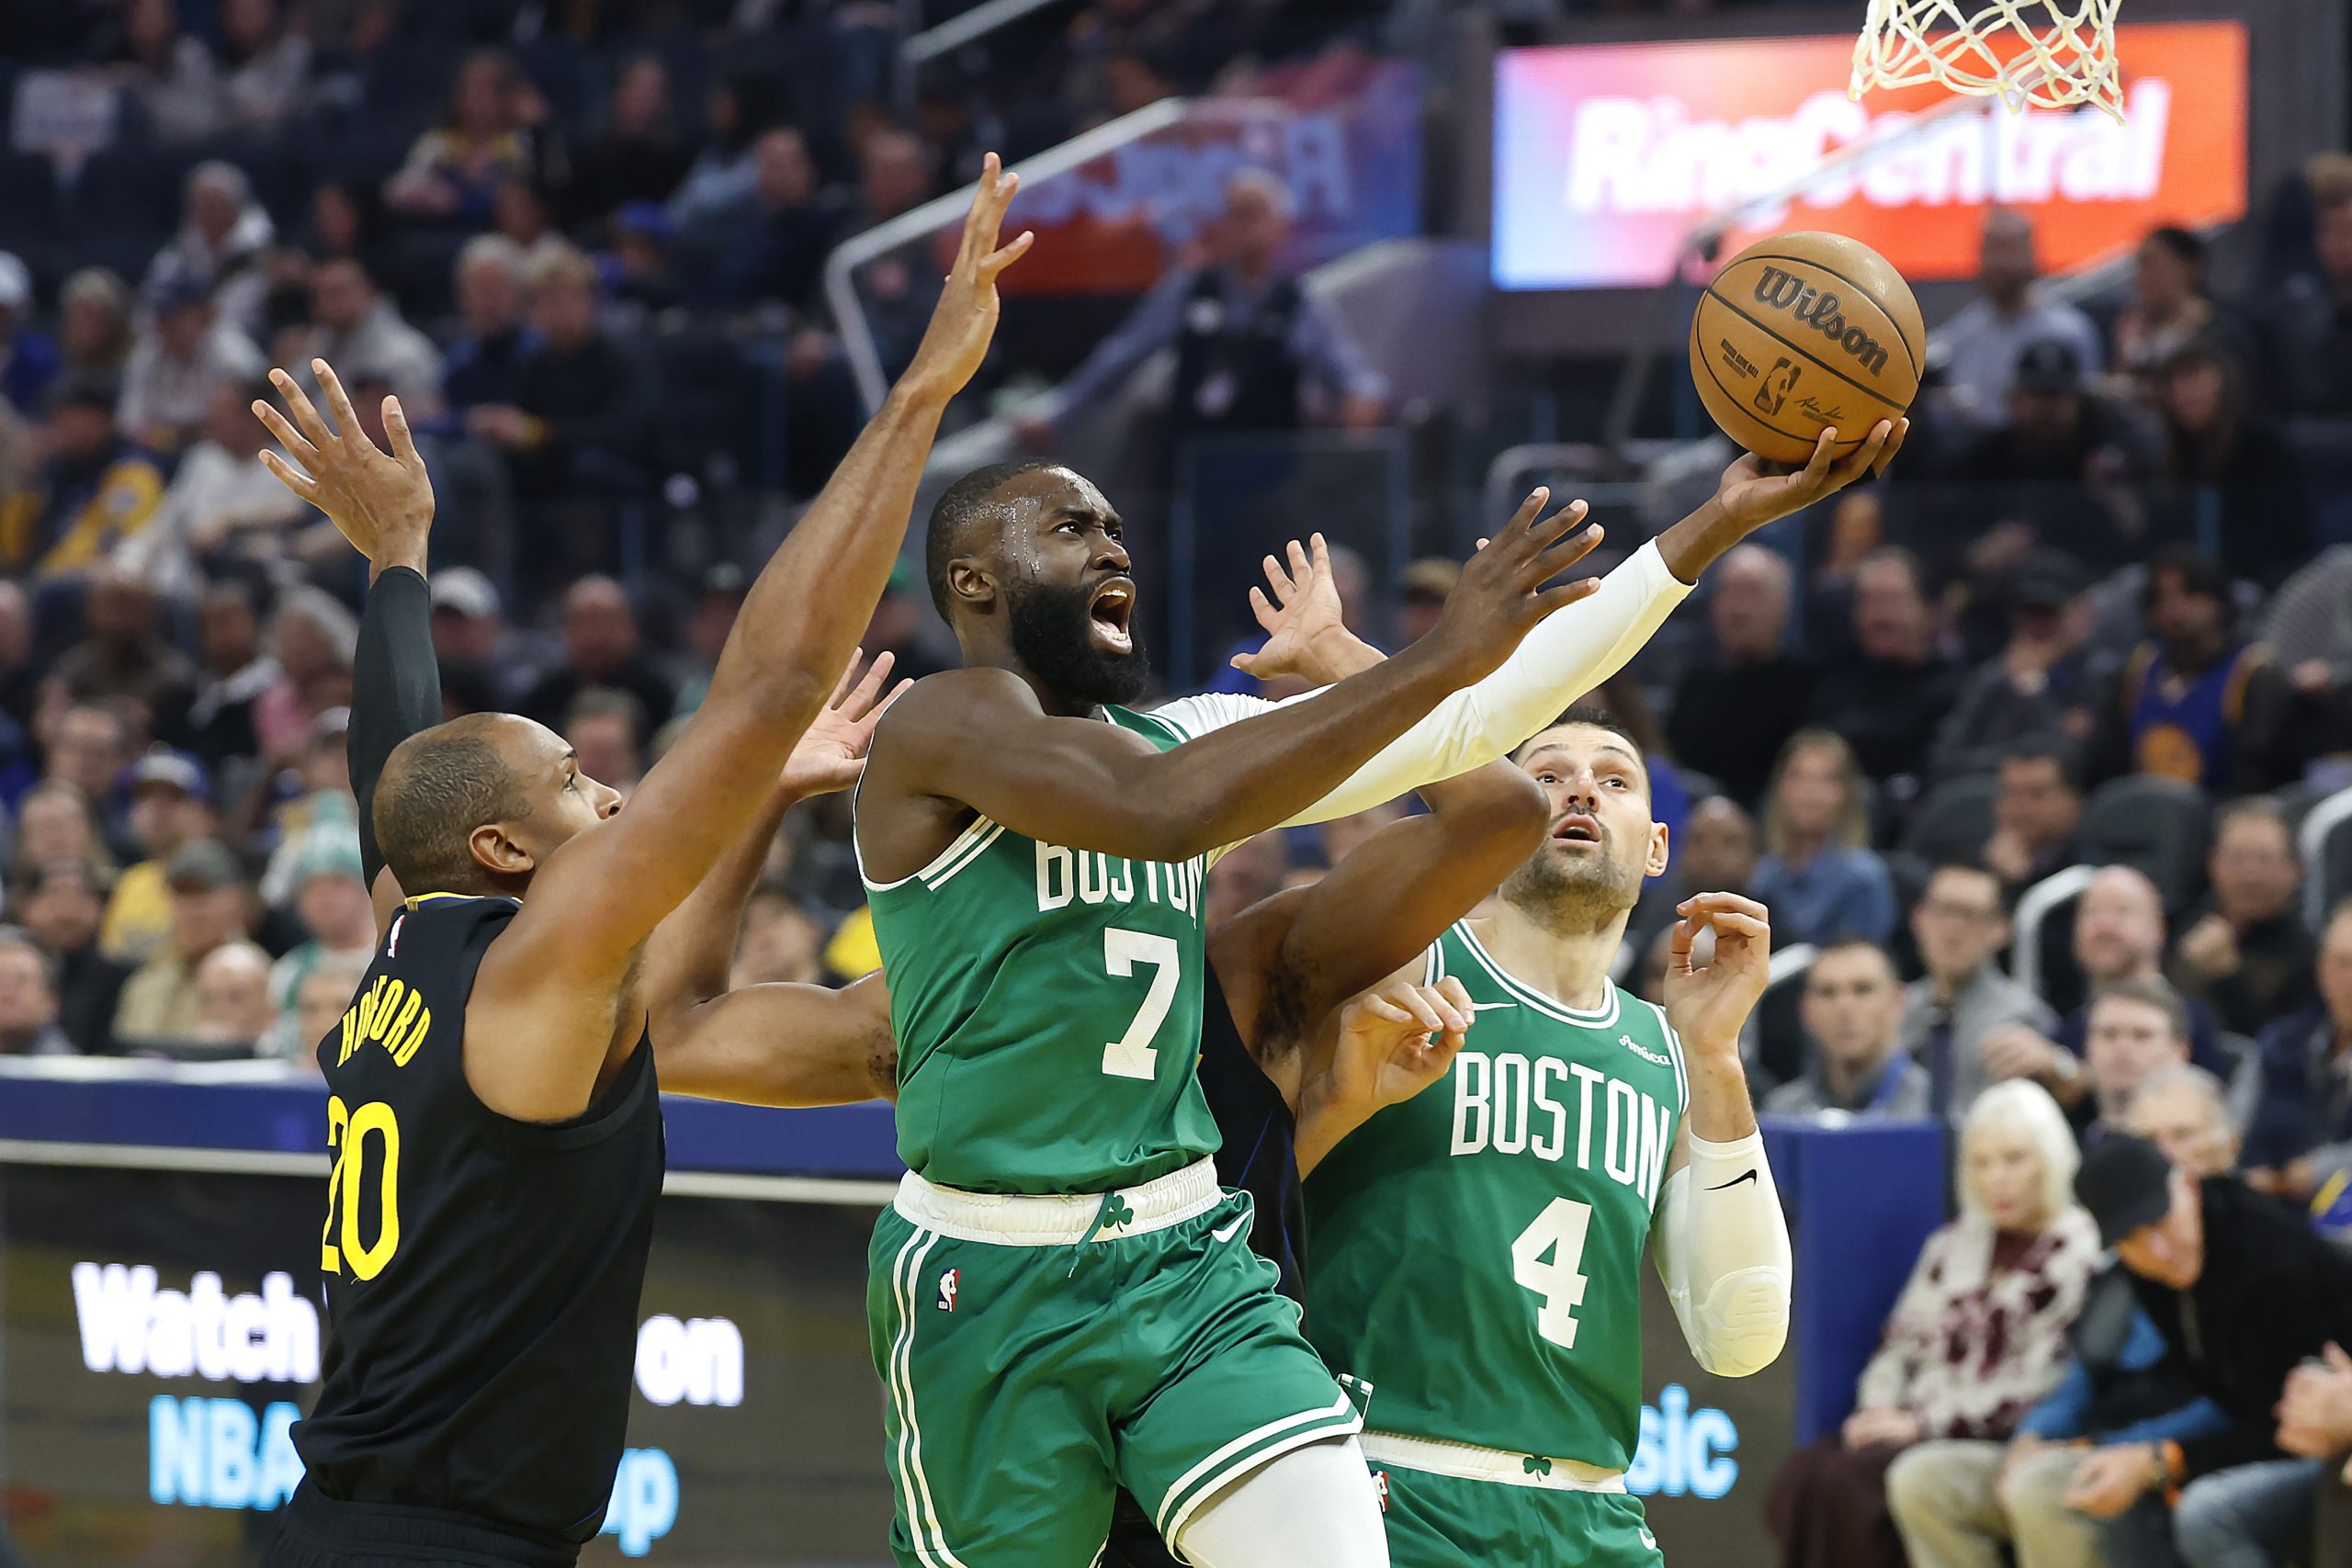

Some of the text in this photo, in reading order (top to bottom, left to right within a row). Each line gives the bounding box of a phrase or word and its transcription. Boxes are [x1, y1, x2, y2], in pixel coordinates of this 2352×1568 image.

[1567, 79, 2168, 228] RingCentral
[1754, 266, 1888, 378] Wilson
[337, 975, 432, 1068] HOFORD
[1102, 927, 1180, 1080] 7
[1618, 1035, 1671, 1066] Amica
[322, 1095, 400, 1281] 20
[1451, 1052, 1670, 1214] BOSTON
[72, 1262, 744, 1406] Watch on
[1511, 1196, 1592, 1349] 4
[149, 1394, 306, 1511] NBA
